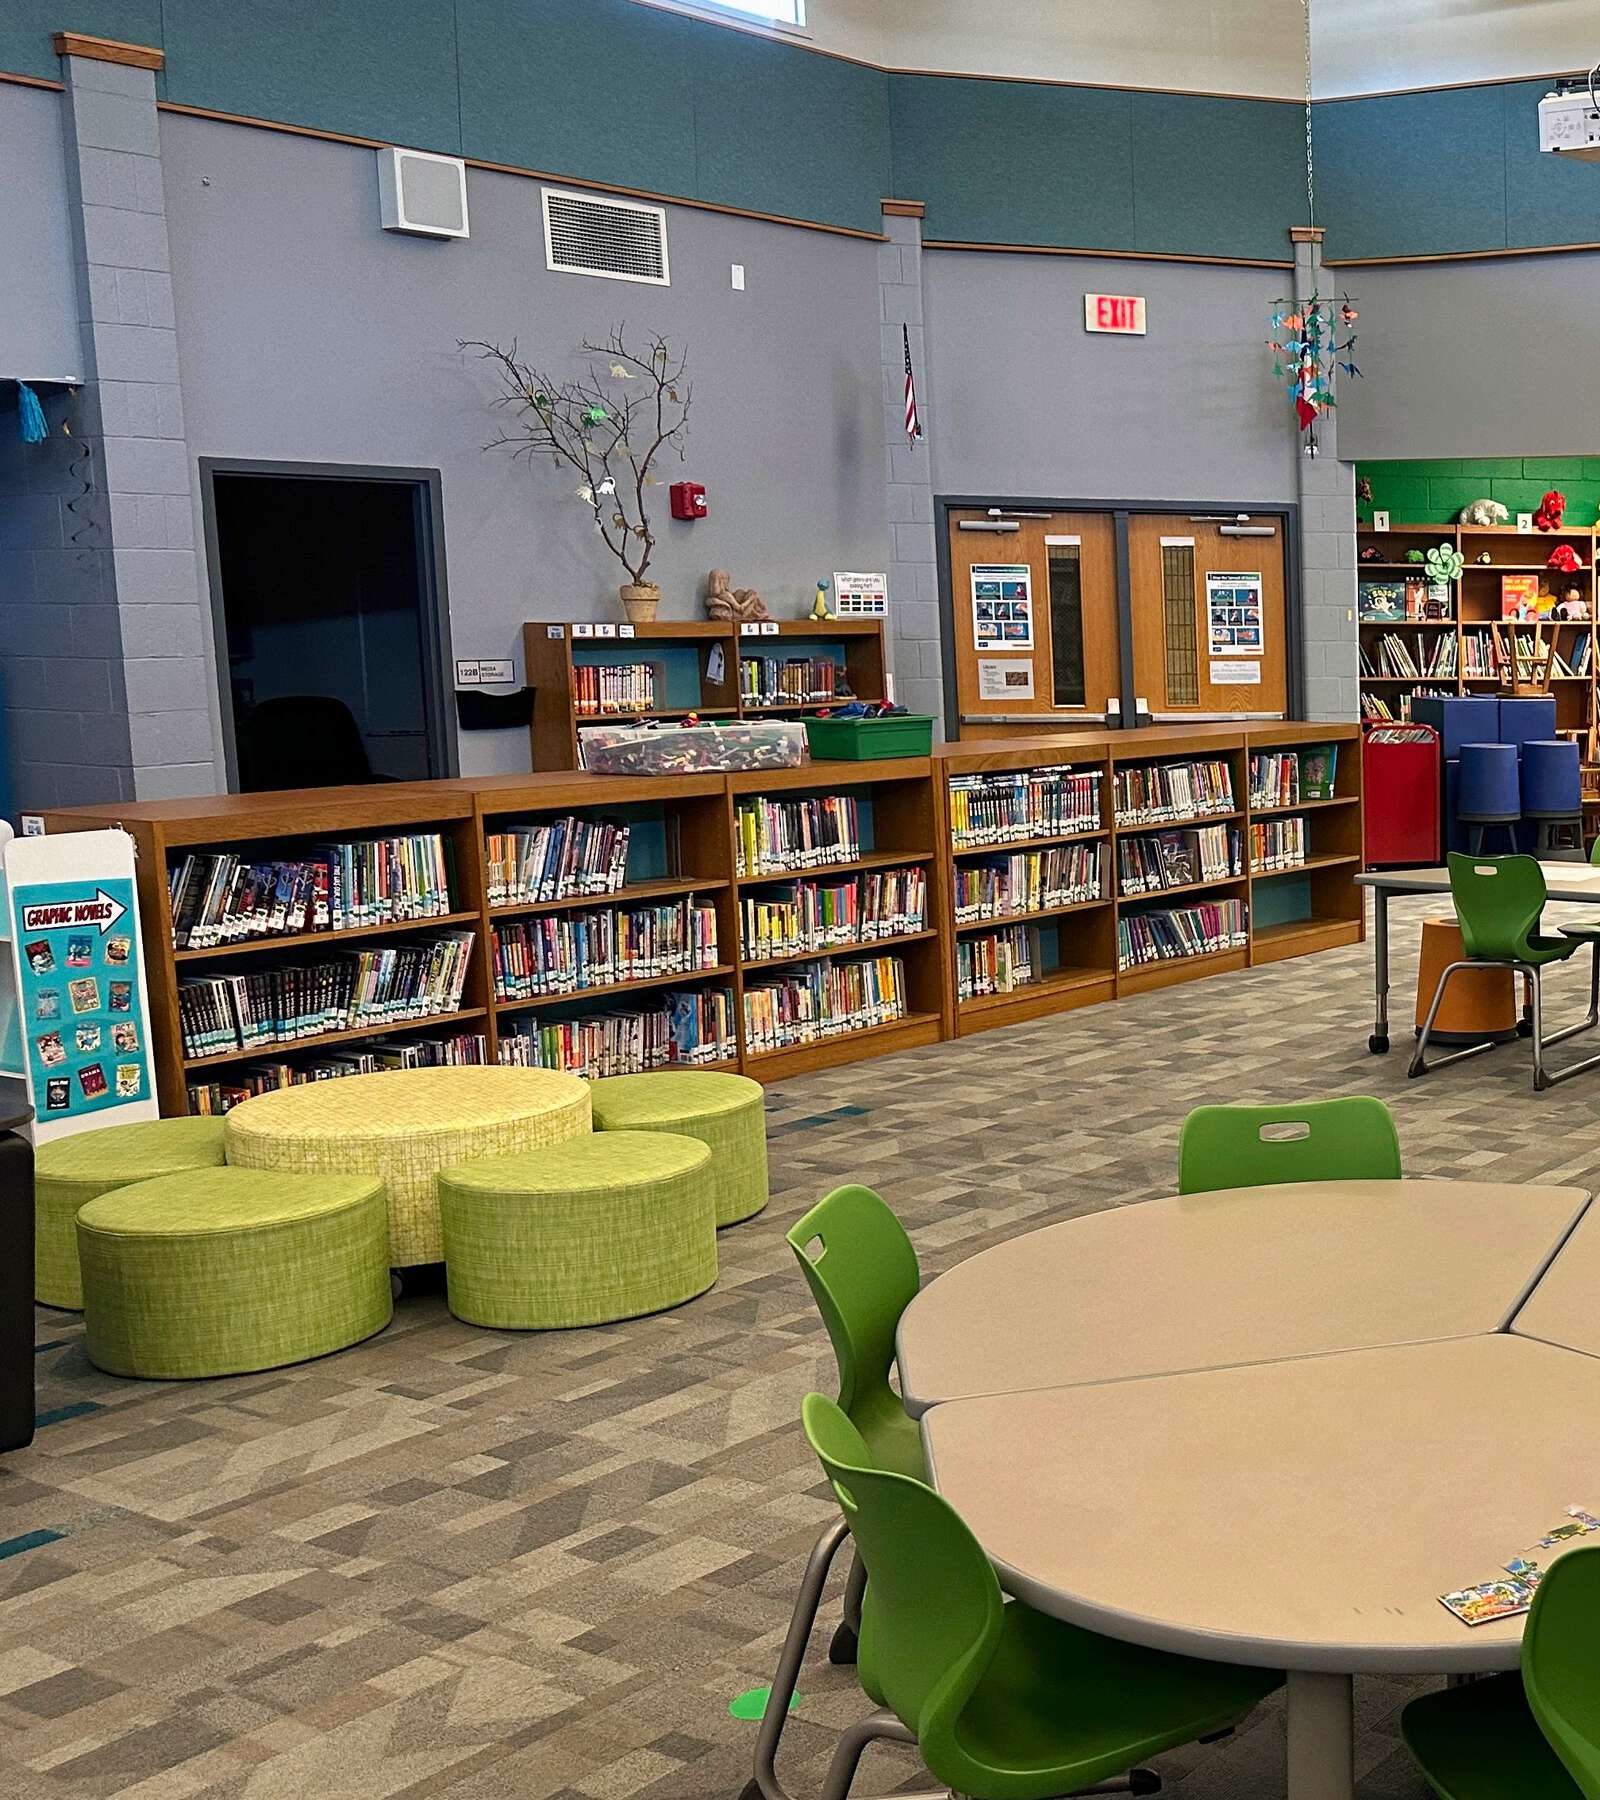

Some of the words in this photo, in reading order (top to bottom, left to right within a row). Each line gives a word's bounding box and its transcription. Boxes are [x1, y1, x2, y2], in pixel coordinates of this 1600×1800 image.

[1097, 297, 1136, 328] EXIT
[1379, 516, 1384, 527] 1
[1522, 519, 1528, 529] 2
[27, 906, 72, 927] GRAPHIC
[74, 903, 112, 922] NOVELS
